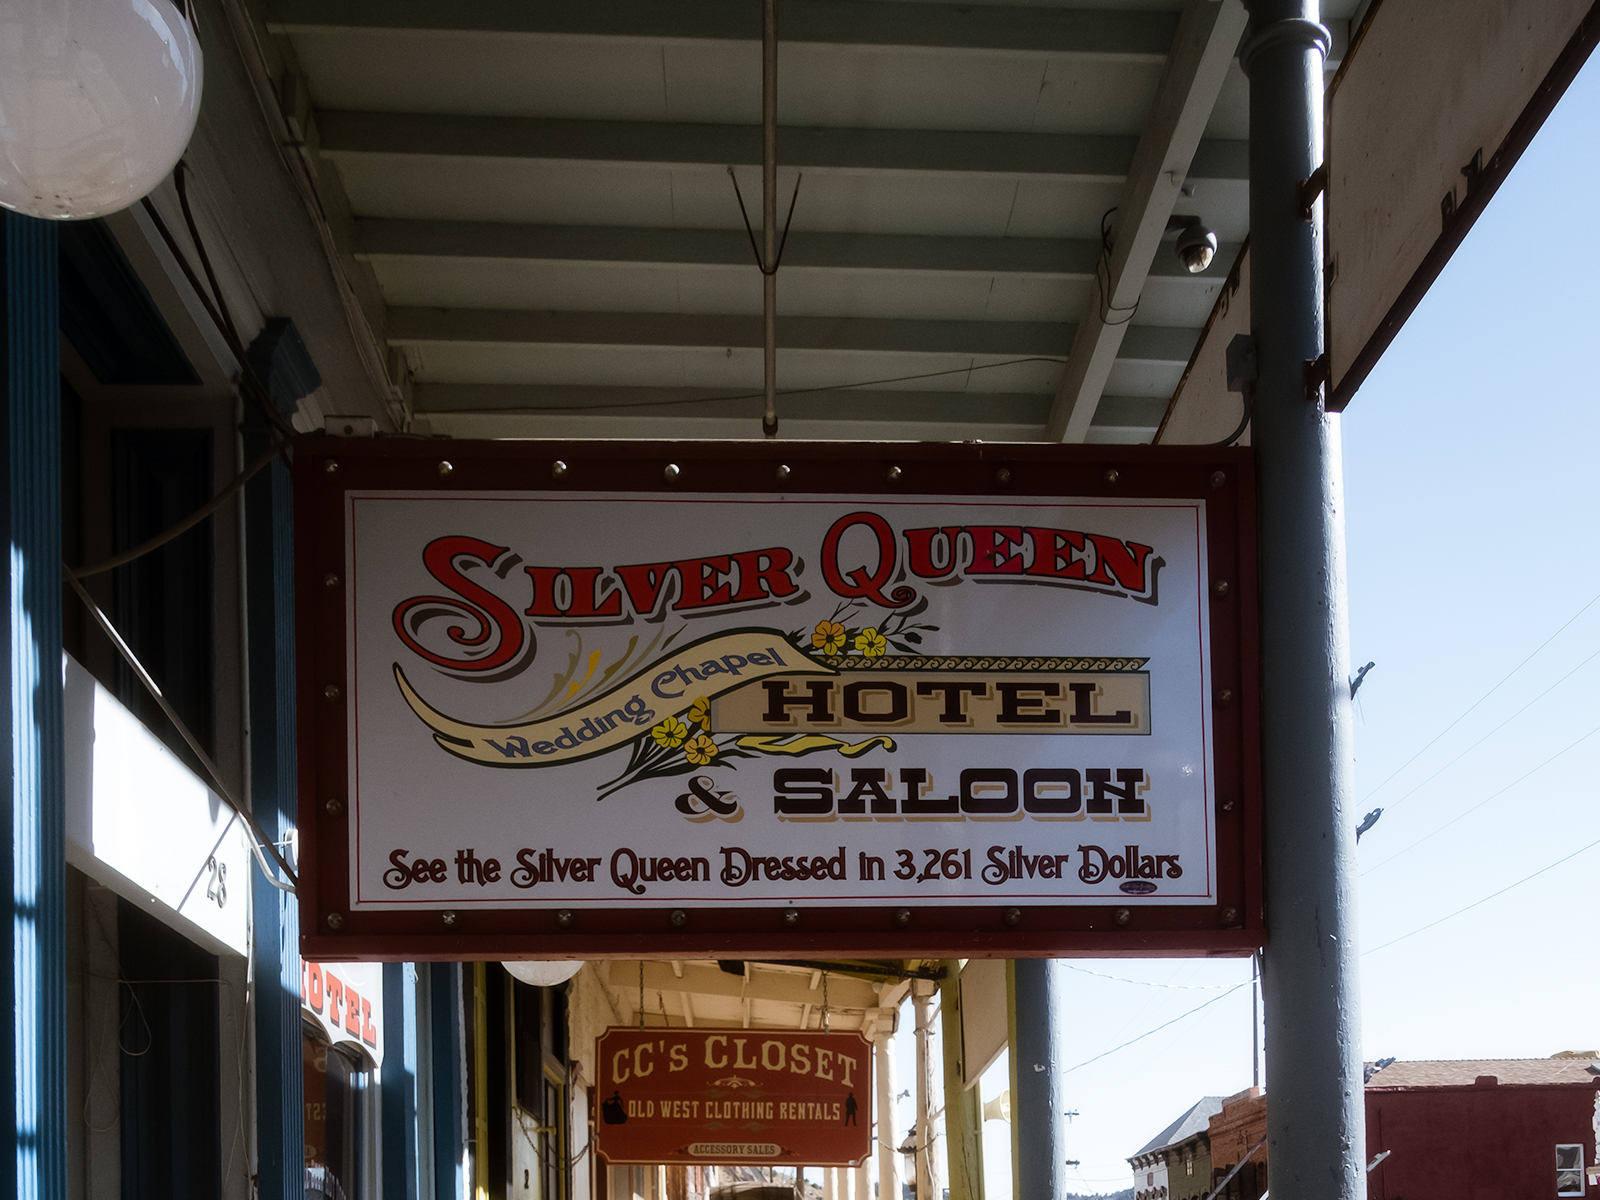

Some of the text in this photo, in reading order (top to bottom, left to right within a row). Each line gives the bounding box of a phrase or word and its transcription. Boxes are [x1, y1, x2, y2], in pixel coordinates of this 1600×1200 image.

[820, 511, 1162, 607] QUEEN
[484, 646, 789, 761] Wedding Chapel
[762, 680, 1137, 730] HOTEL
[674, 767, 1151, 822] & SALOON
[382, 845, 1182, 895] See the Silver Queen Dressed in 3,261 Silver Dollars
[704, 1035, 857, 1088] CLOSET
[628, 1100, 841, 1121] OLD WEST CLOTHING RENTALS
[693, 1145, 775, 1156] ACCESSORY SALES
